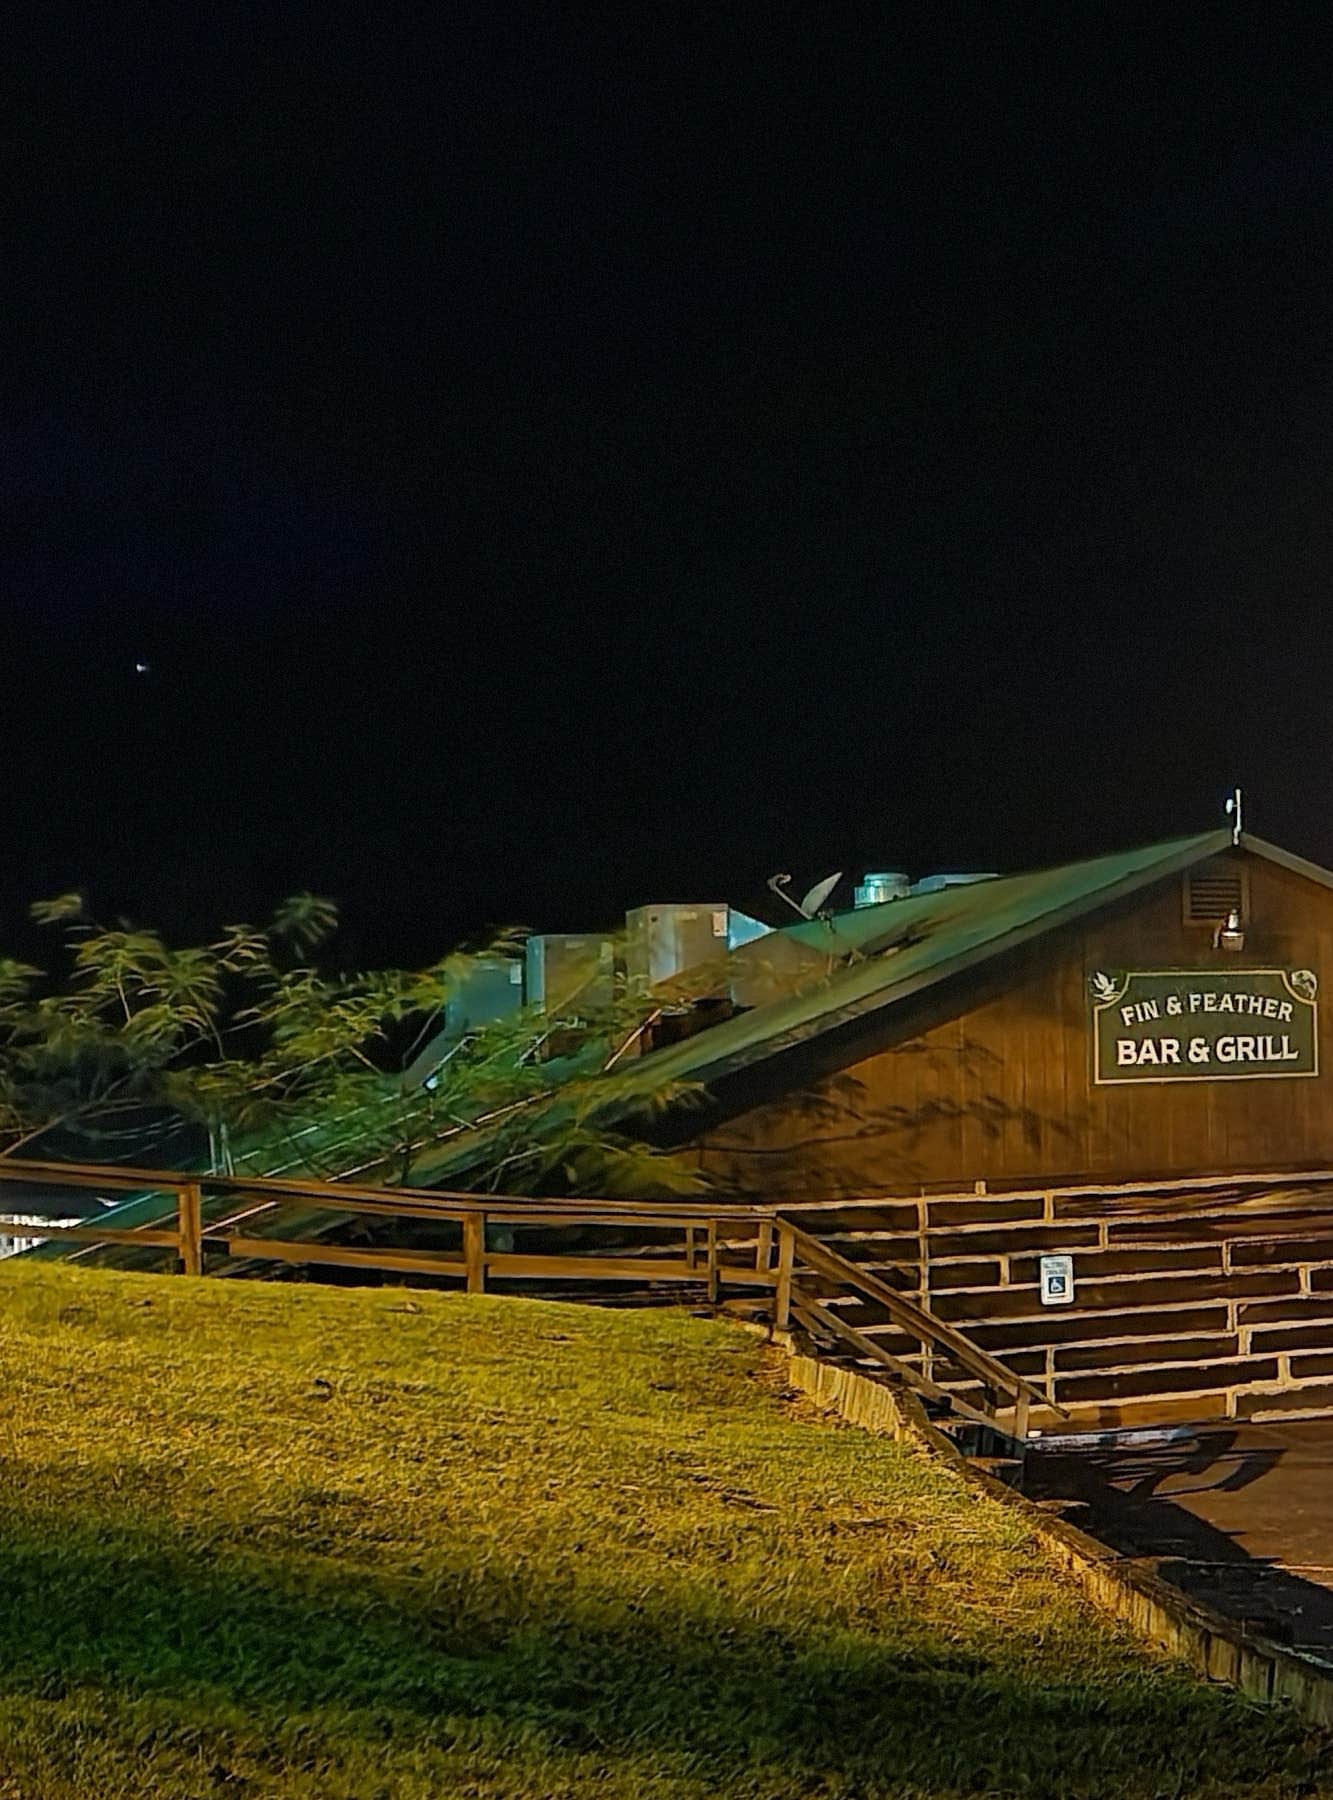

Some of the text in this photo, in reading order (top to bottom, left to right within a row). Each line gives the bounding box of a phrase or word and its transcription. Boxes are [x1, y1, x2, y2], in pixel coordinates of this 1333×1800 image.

[1120, 992, 1294, 1027] FIN & FEATHER
[1116, 1034, 1300, 1066] BAR & GRILL
